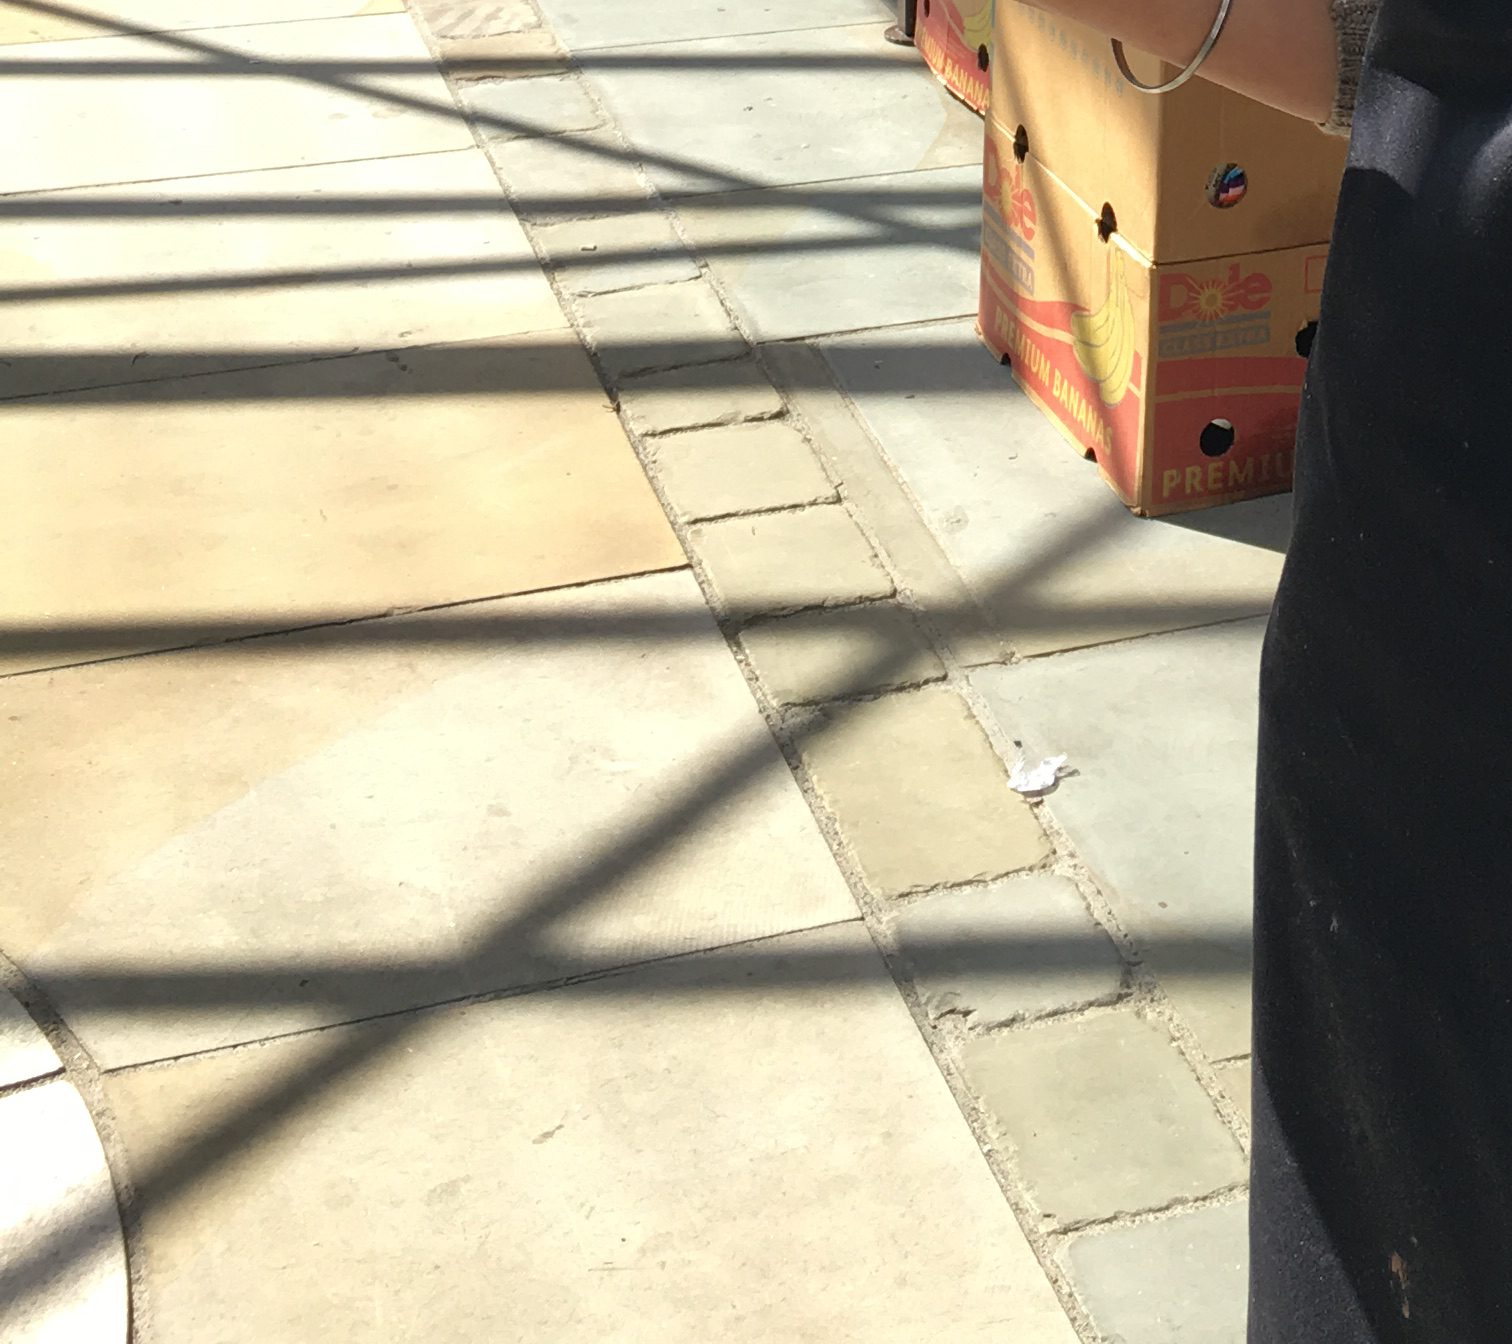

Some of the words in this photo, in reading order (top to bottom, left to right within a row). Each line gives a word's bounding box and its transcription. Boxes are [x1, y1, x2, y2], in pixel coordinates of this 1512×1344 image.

[944, 57, 990, 109] BANANA
[983, 133, 1037, 242] Dole
[1157, 263, 1274, 322] Dole
[993, 305, 1050, 388] PREMIUM
[1052, 368, 1113, 455] BANANAS
[1161, 450, 1295, 498] PREMIU
